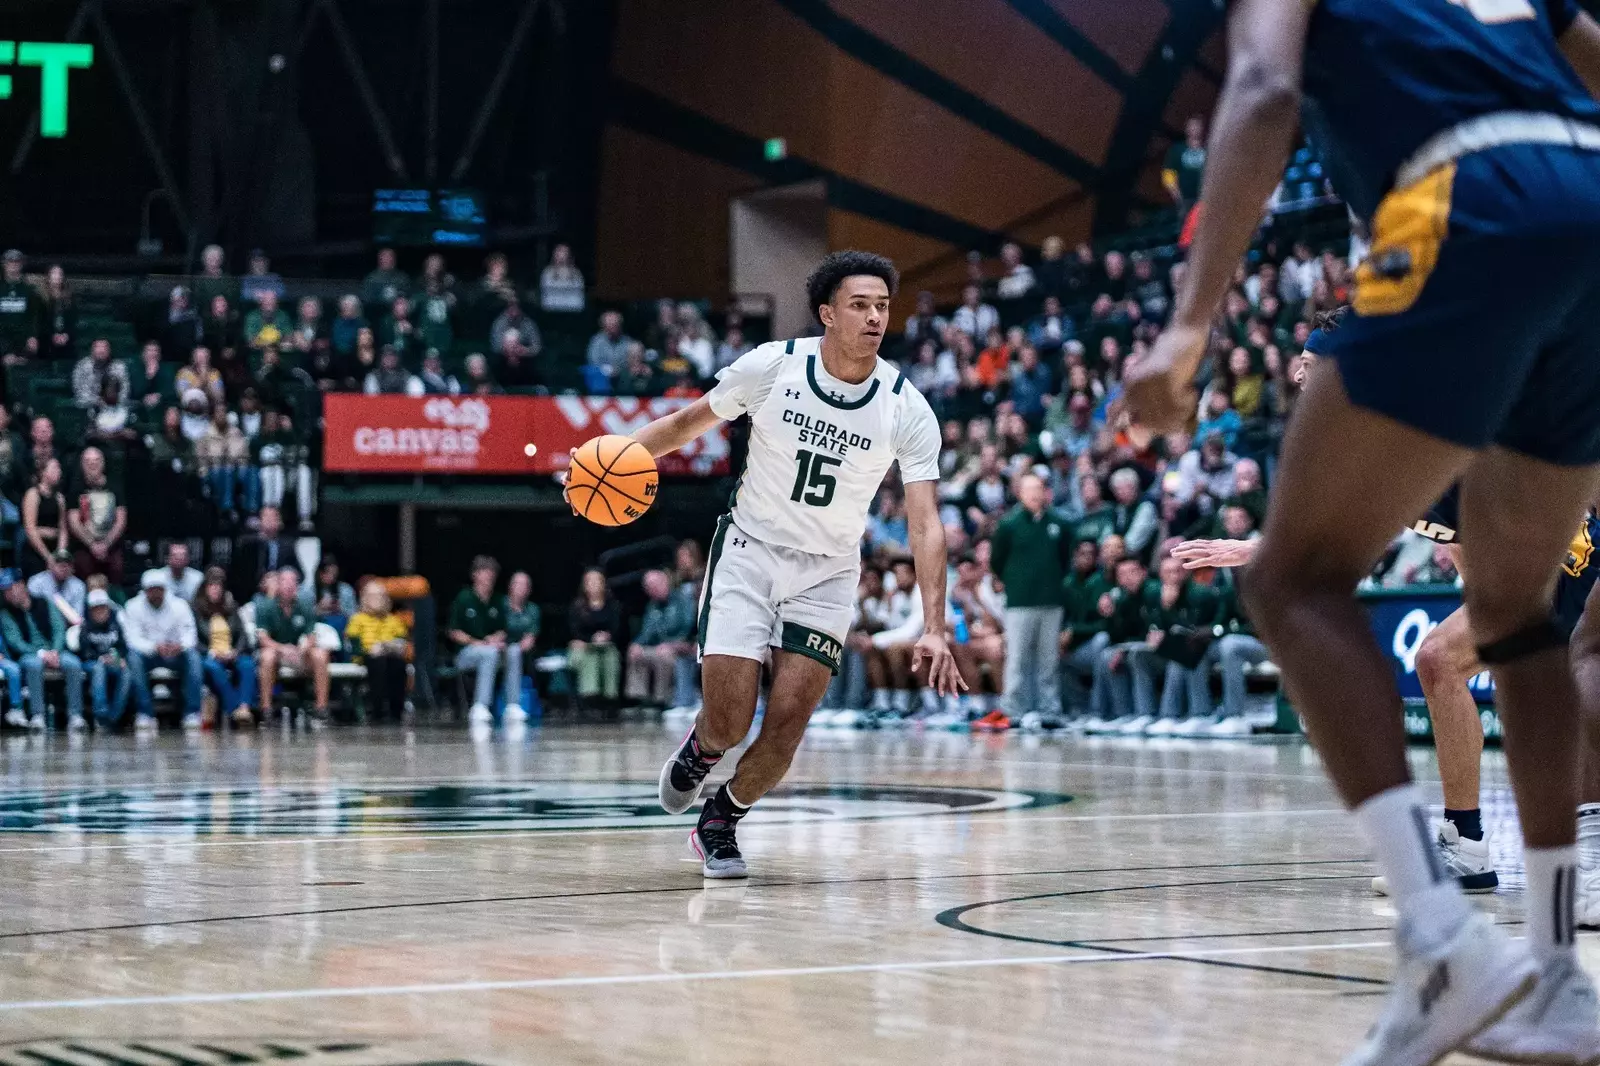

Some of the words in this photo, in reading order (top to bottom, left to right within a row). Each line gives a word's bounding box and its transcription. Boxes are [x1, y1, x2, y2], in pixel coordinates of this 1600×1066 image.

[354, 427, 480, 455] canvas
[782, 409, 872, 451] COLORADO
[798, 429, 849, 456] STATE
[790, 449, 843, 507] 15
